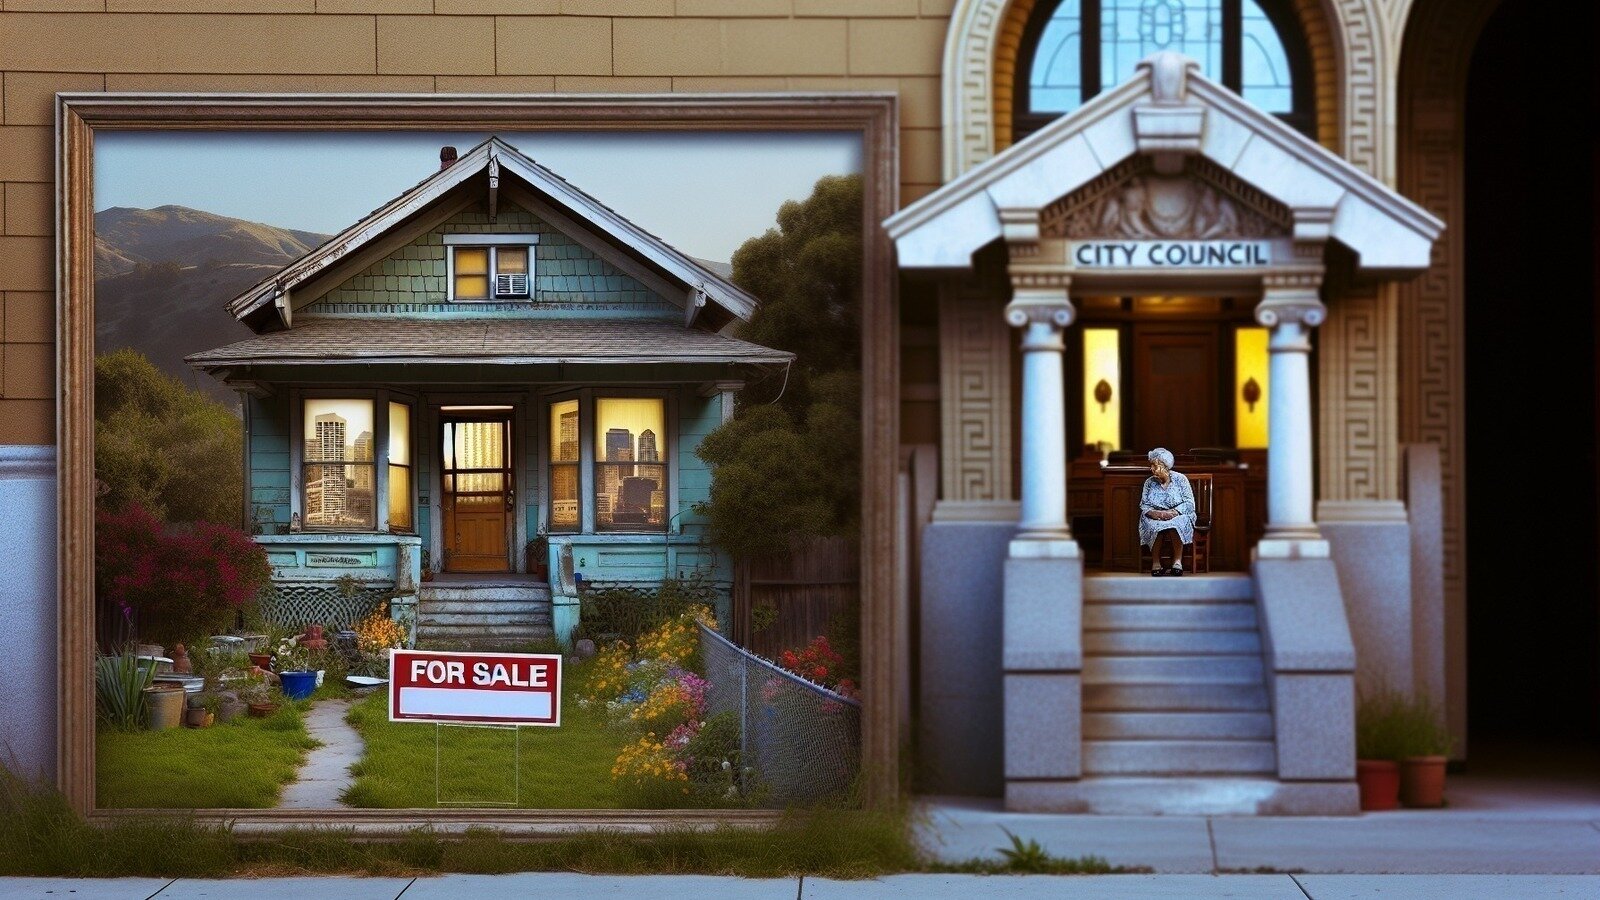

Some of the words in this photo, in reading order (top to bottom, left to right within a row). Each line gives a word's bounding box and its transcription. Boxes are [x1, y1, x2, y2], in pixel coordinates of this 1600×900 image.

[1077, 244, 1137, 265] CITY
[1148, 244, 1267, 265] COUNCIL
[411, 660, 465, 685] FOR
[473, 662, 548, 687] SALE
